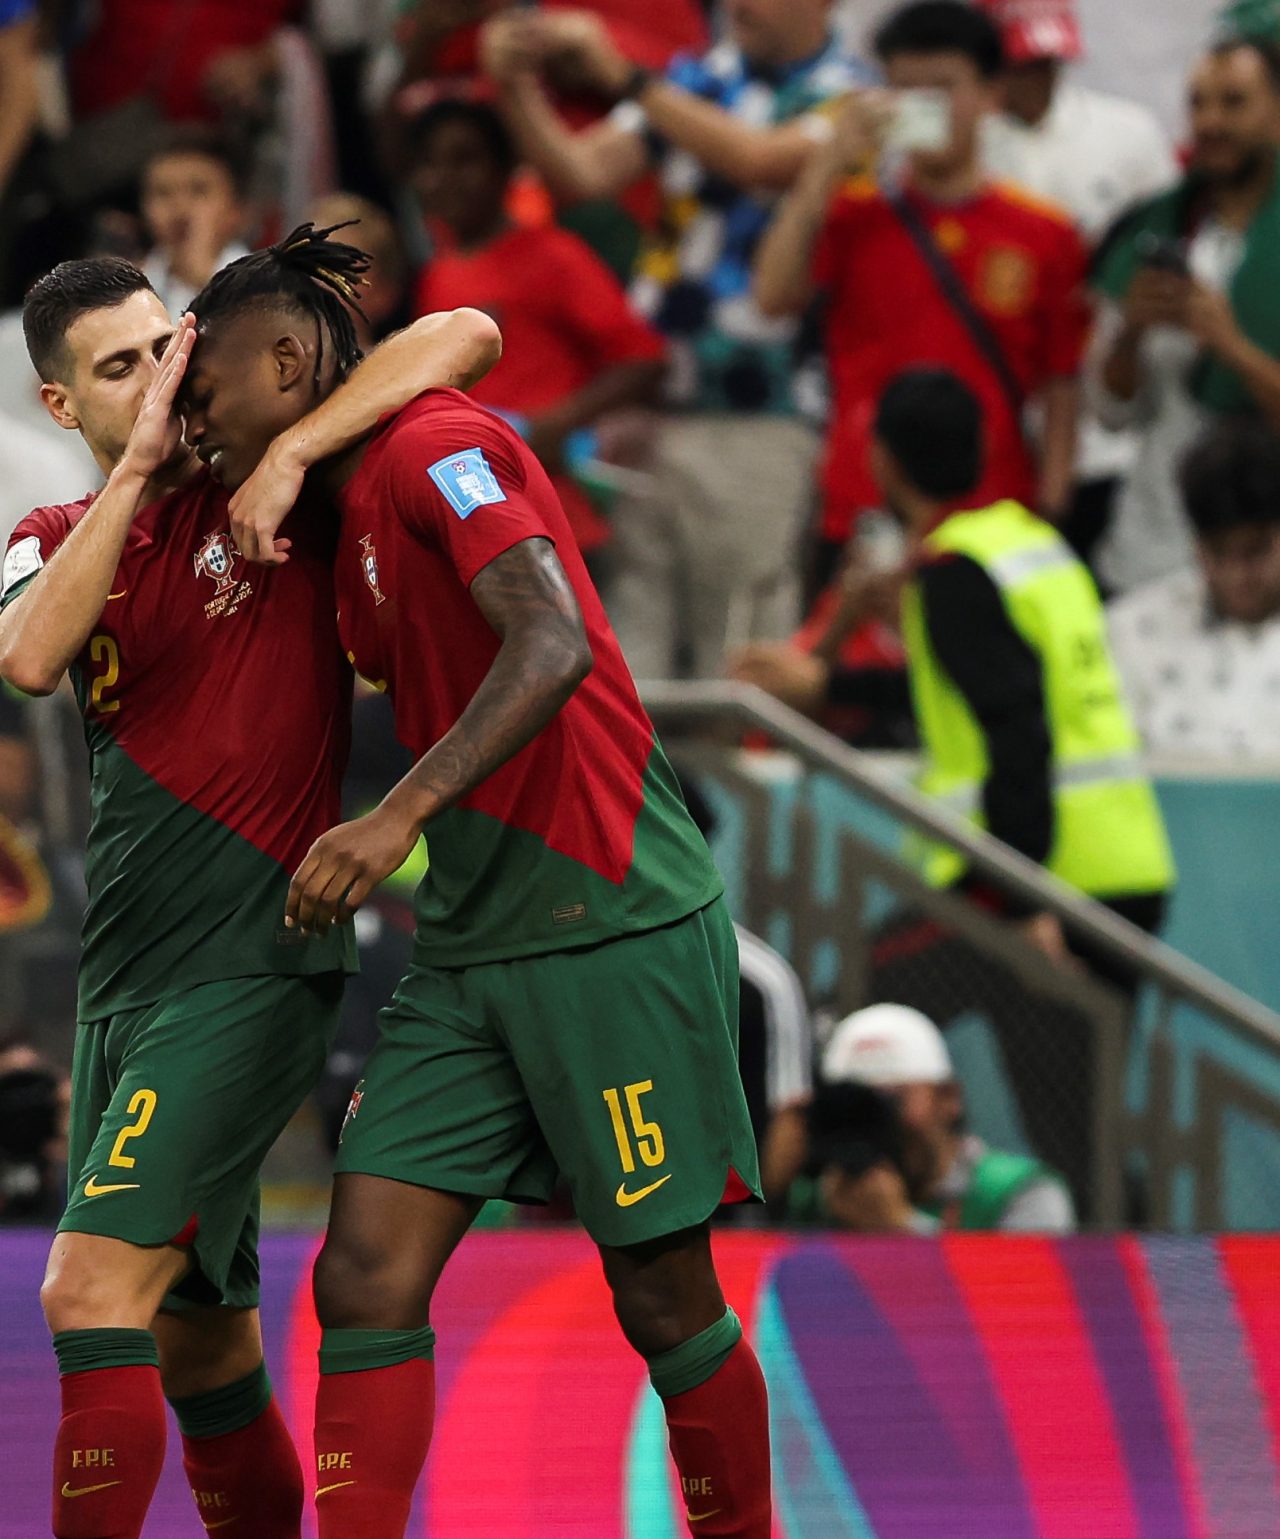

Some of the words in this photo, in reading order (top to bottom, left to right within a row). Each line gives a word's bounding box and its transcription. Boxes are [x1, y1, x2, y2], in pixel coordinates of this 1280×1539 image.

[90, 635, 120, 713] 2
[108, 1088, 157, 1169] 2
[602, 1079, 665, 1173] 15
